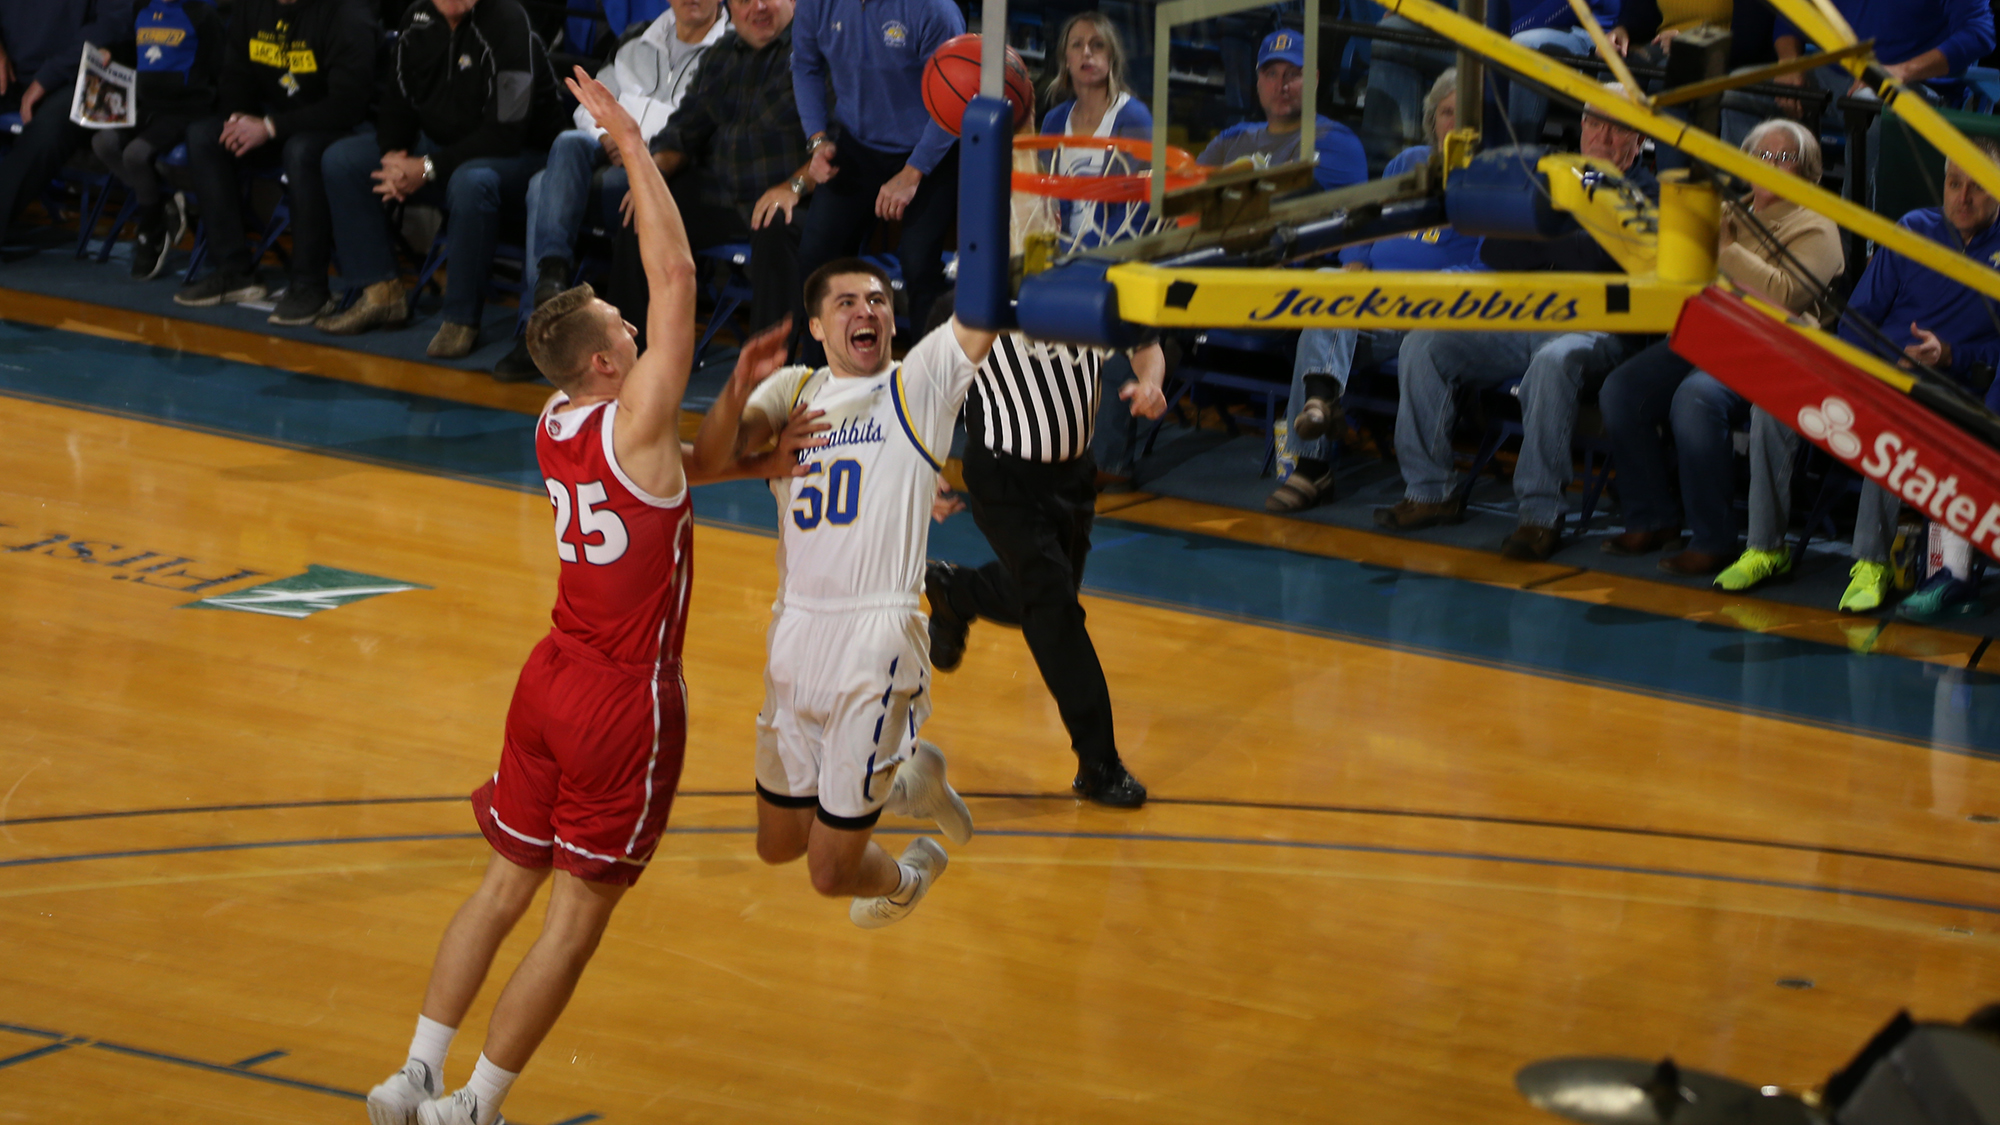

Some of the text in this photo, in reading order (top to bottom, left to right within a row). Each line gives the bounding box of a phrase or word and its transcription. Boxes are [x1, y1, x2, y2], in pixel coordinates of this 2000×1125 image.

[1249, 287, 1578, 321] Jackrabbits
[797, 415, 885, 465] abbits
[792, 457, 864, 533] 50
[1861, 431, 1977, 533] State
[545, 477, 630, 566] 25
